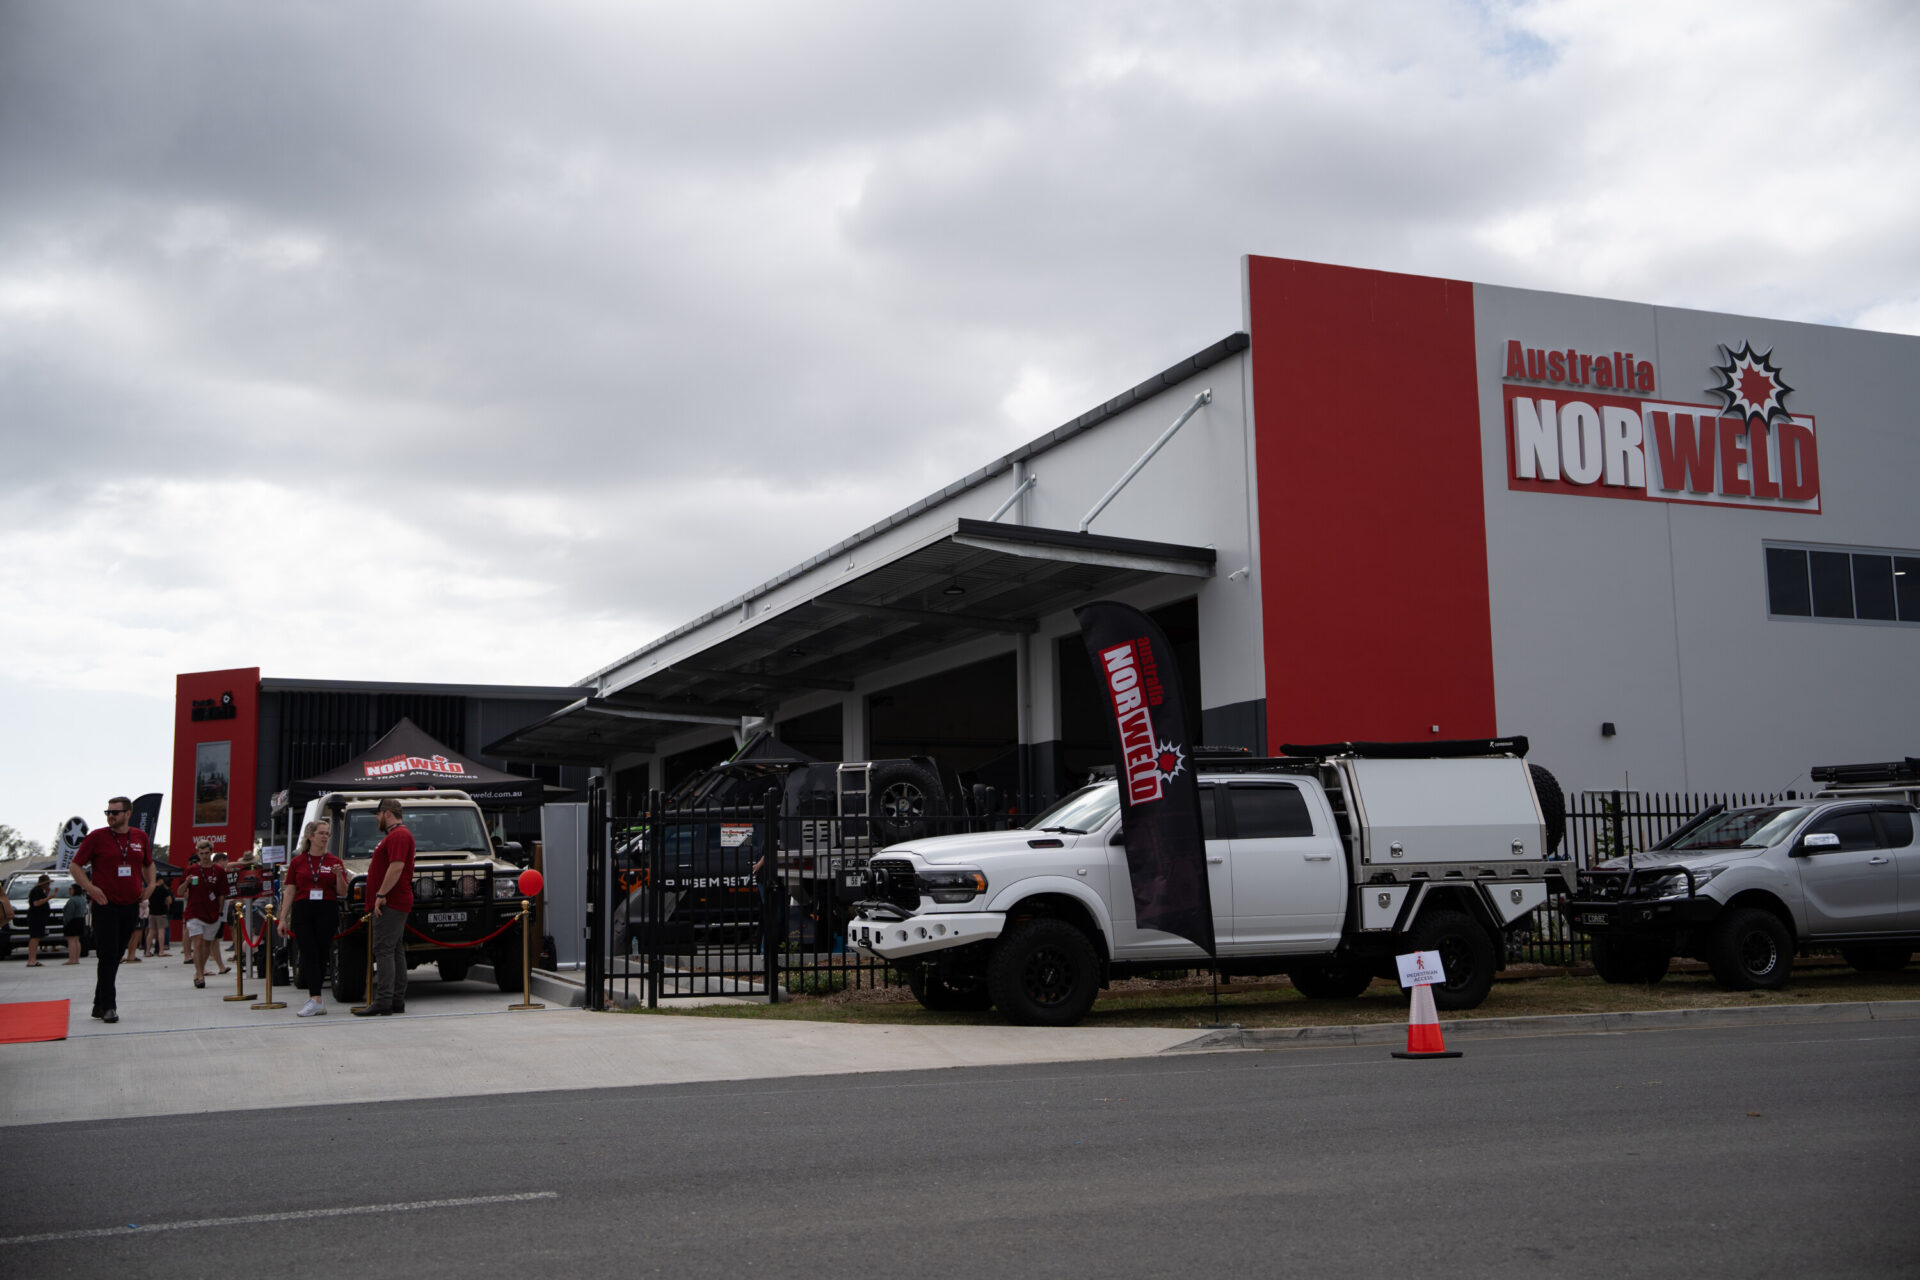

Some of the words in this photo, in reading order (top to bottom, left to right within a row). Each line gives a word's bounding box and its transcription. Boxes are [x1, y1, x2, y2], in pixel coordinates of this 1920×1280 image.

[1506, 340, 1655, 392] Australia
[1511, 396, 1819, 502] NORWELD
[1103, 643, 1158, 801] NORWELD
[366, 757, 464, 777] NORWELD
[1406, 970, 1438, 978] PEDESTRIAN
